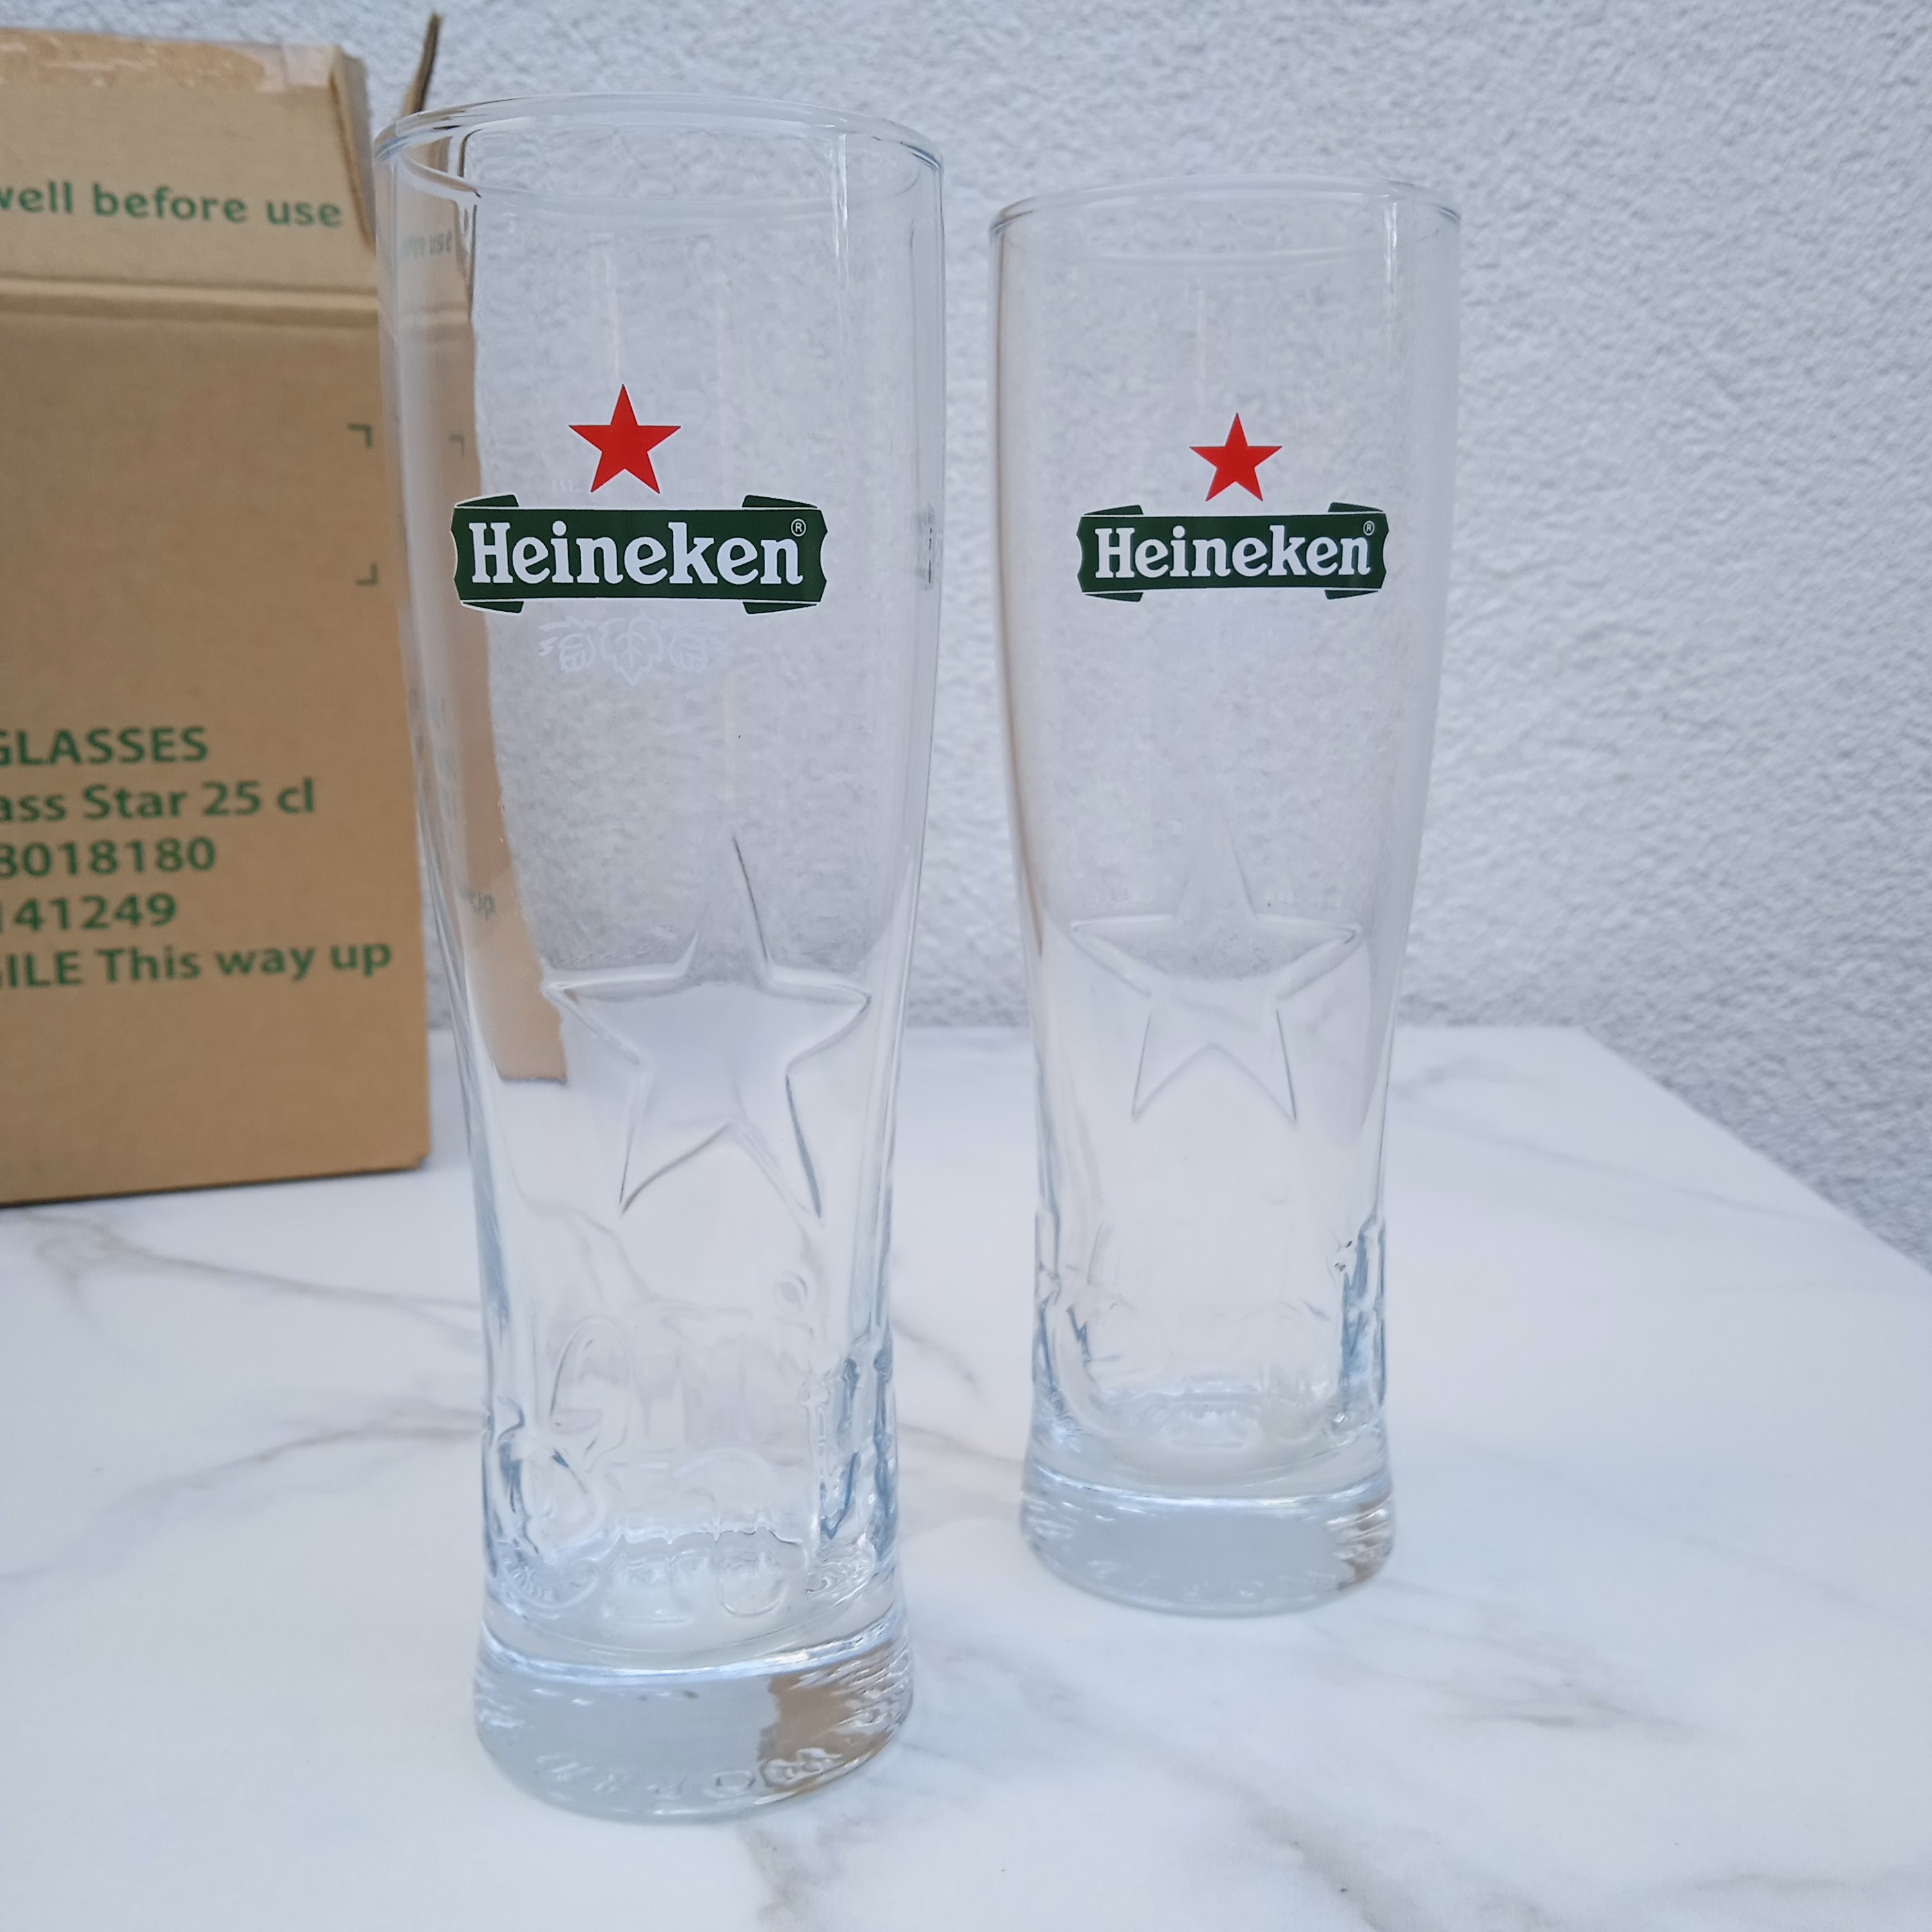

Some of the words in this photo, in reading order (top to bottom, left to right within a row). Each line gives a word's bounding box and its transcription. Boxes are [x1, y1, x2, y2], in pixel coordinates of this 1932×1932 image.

[93, 183, 248, 223] before
[267, 201, 342, 227] use
[468, 520, 804, 585] Heineken
[1094, 524, 1372, 579] Heineken
[83, 784, 189, 820] Star
[203, 781, 263, 817] 25
[277, 778, 315, 814] cl
[0, 893, 177, 933] 41249
[0, 951, 82, 988] ILE
[96, 945, 201, 983] This
[215, 947, 316, 981] way
[331, 943, 392, 978] up
